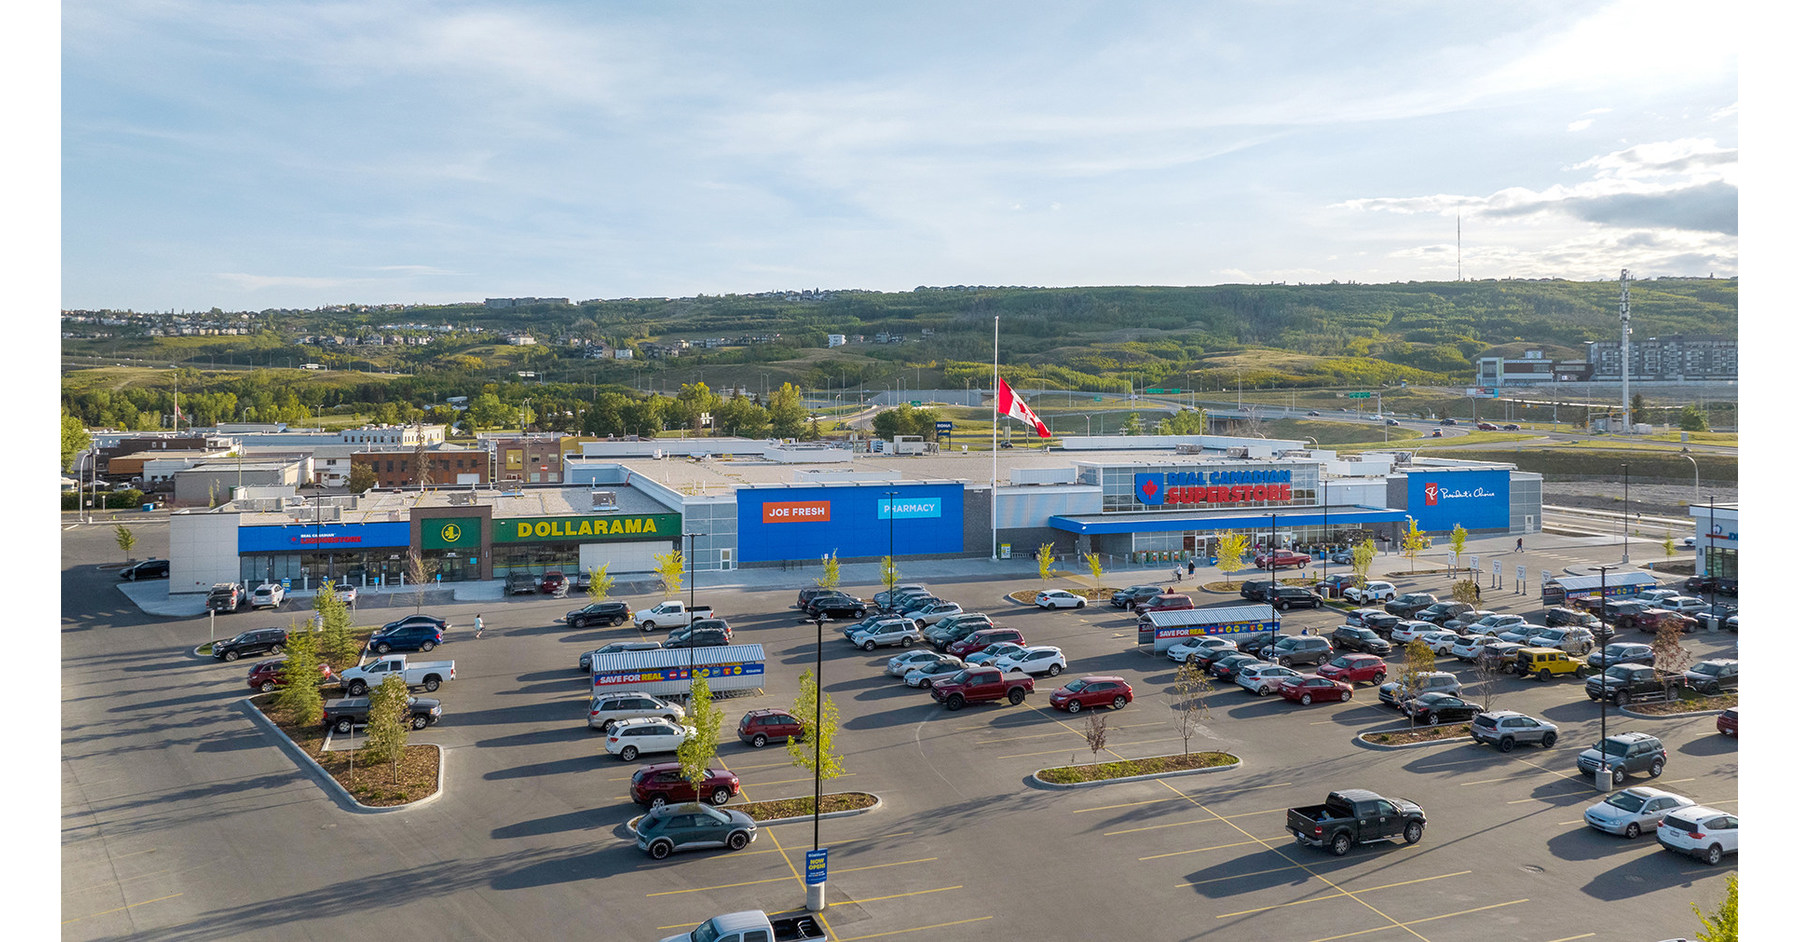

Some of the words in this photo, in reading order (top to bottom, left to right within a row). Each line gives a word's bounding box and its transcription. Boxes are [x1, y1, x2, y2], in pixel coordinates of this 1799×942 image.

[1167, 472, 1206, 486] REAL
[1209, 470, 1291, 485] CANADIAN
[1167, 484, 1291, 505] SUPERSTORE
[1440, 488, 1472, 499] President's
[1473, 487, 1495, 498] Choice
[769, 508, 790, 517] JOE
[792, 507, 825, 516] FRESH
[884, 503, 935, 513] PHARMACY
[517, 518, 657, 537] DOLLARAMA
[600, 675, 623, 683] SAVE
[622, 674, 641, 682] FOR
